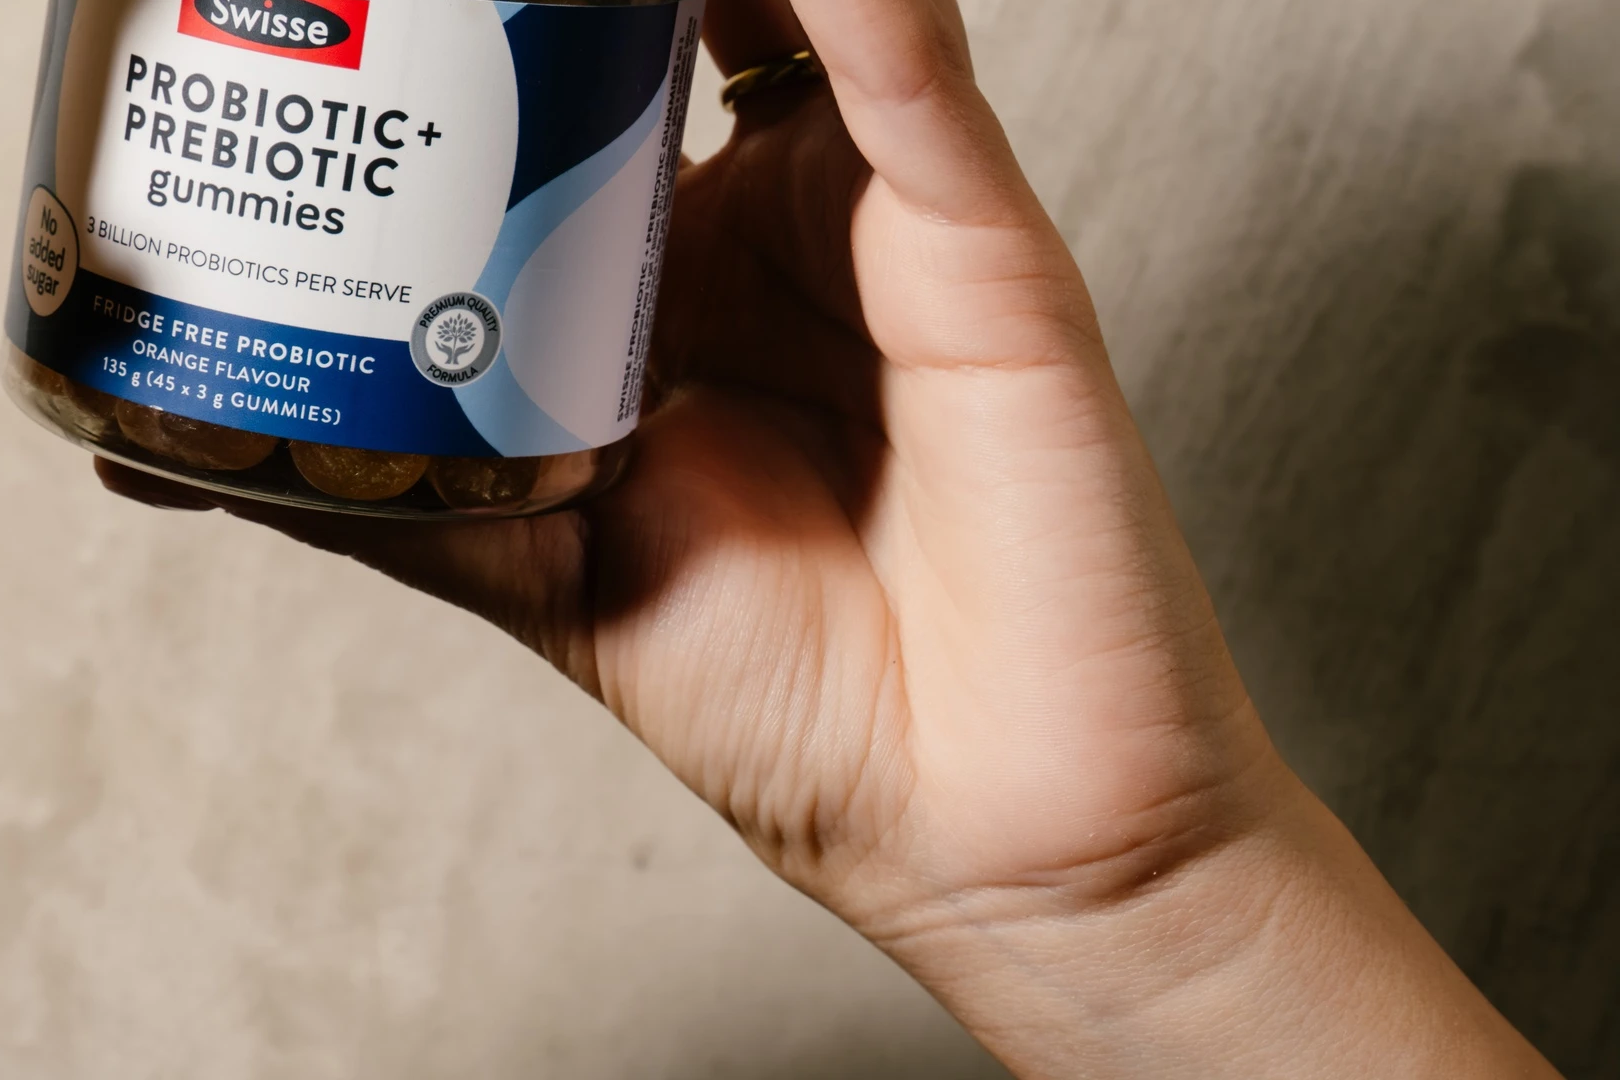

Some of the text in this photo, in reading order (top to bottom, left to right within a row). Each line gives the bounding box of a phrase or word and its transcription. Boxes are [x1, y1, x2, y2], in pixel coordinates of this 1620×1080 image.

[124, 103, 399, 197] PREBIOTIC
[40, 205, 57, 236] No
[147, 170, 345, 234] gummies
[29, 236, 65, 272] added
[86, 216, 412, 303] 3 BILLION PROBIOTICS PER SERVE
[617, 360, 631, 421] SWISSE
[627, 262, 647, 355] PROBIOTIC
[645, 152, 665, 243] PREBIOTIC
[660, 64, 679, 147] GUMMIES
[27, 264, 59, 296] sugar
[93, 295, 376, 374] FRIDGE FREE PROBIOTIC
[419, 296, 498, 332] PREMIUM QUALITY
[103, 357, 341, 425] 135 g (45 x 3 g GUMMIES)
[132, 340, 311, 393] ORANGE FLAVOUR
[427, 364, 478, 383] FORMULA
